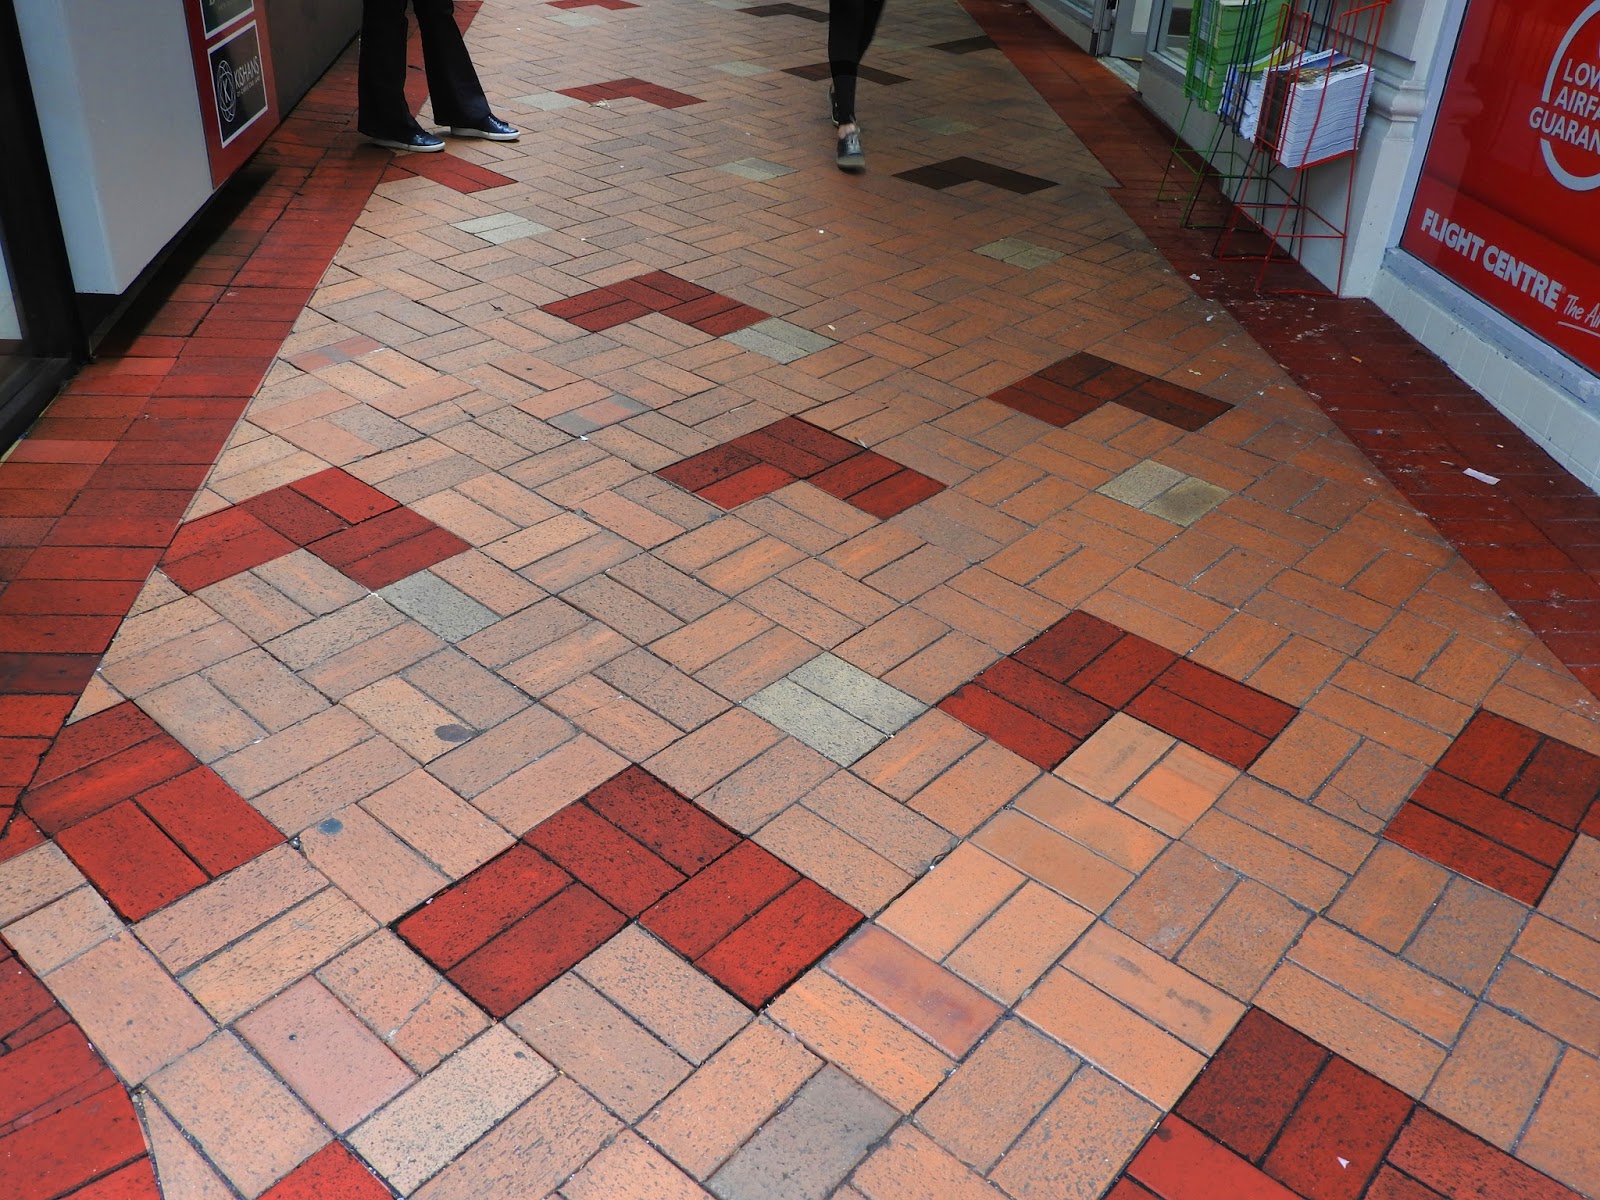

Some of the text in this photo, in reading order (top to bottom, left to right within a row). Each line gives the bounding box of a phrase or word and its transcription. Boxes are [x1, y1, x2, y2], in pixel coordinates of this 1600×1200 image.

[1420, 208, 1485, 262] FLIGHT
[1483, 245, 1563, 310] CENTRE
[1563, 294, 1585, 320] The
